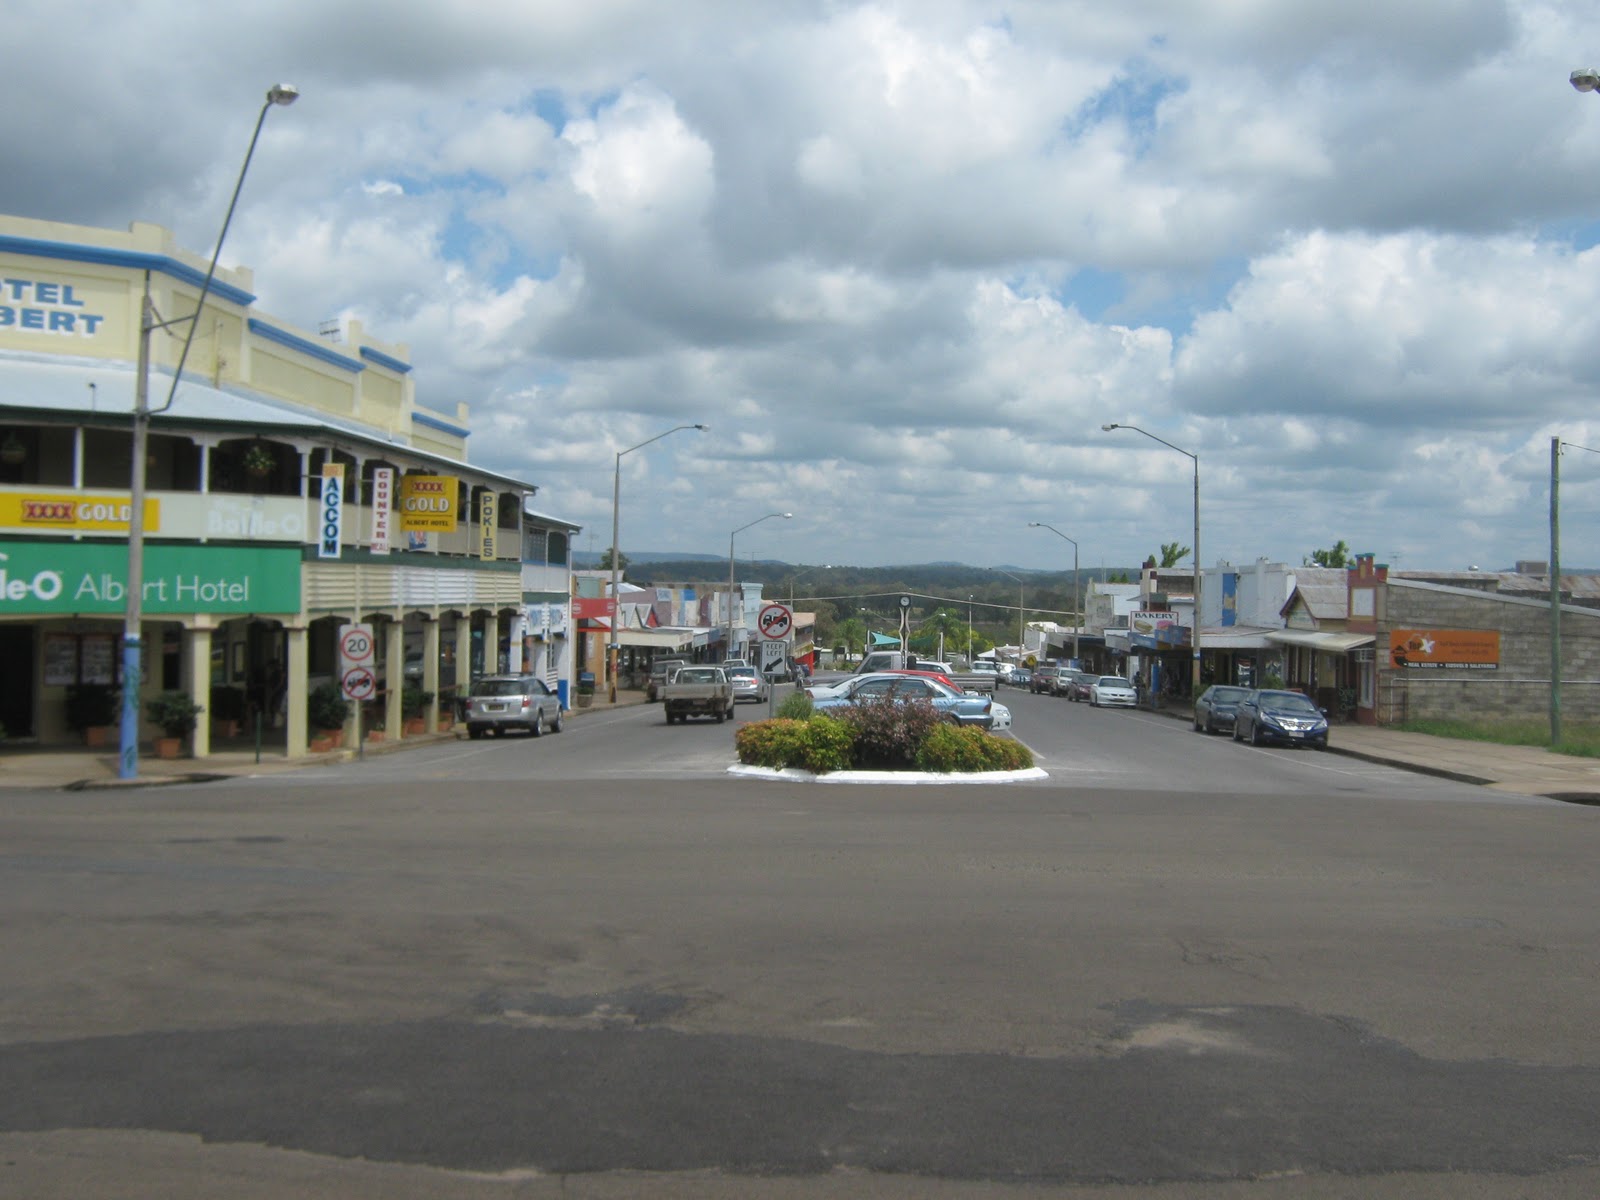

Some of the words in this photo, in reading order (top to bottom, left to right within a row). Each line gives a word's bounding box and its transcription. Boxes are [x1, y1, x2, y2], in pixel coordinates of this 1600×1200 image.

[0, 278, 85, 307] TEL
[415, 482, 443, 492] XXXX
[25, 502, 73, 520] XXXX
[77, 503, 131, 521] GOLD
[323, 477, 338, 554] ACCOM
[376, 471, 388, 539] COUNTER
[406, 497, 450, 512] GOLD
[483, 496, 493, 557] POKIES
[74, 573, 168, 602] Albrt
[176, 575, 250, 603] Hotel
[348, 639, 368, 653] 20
